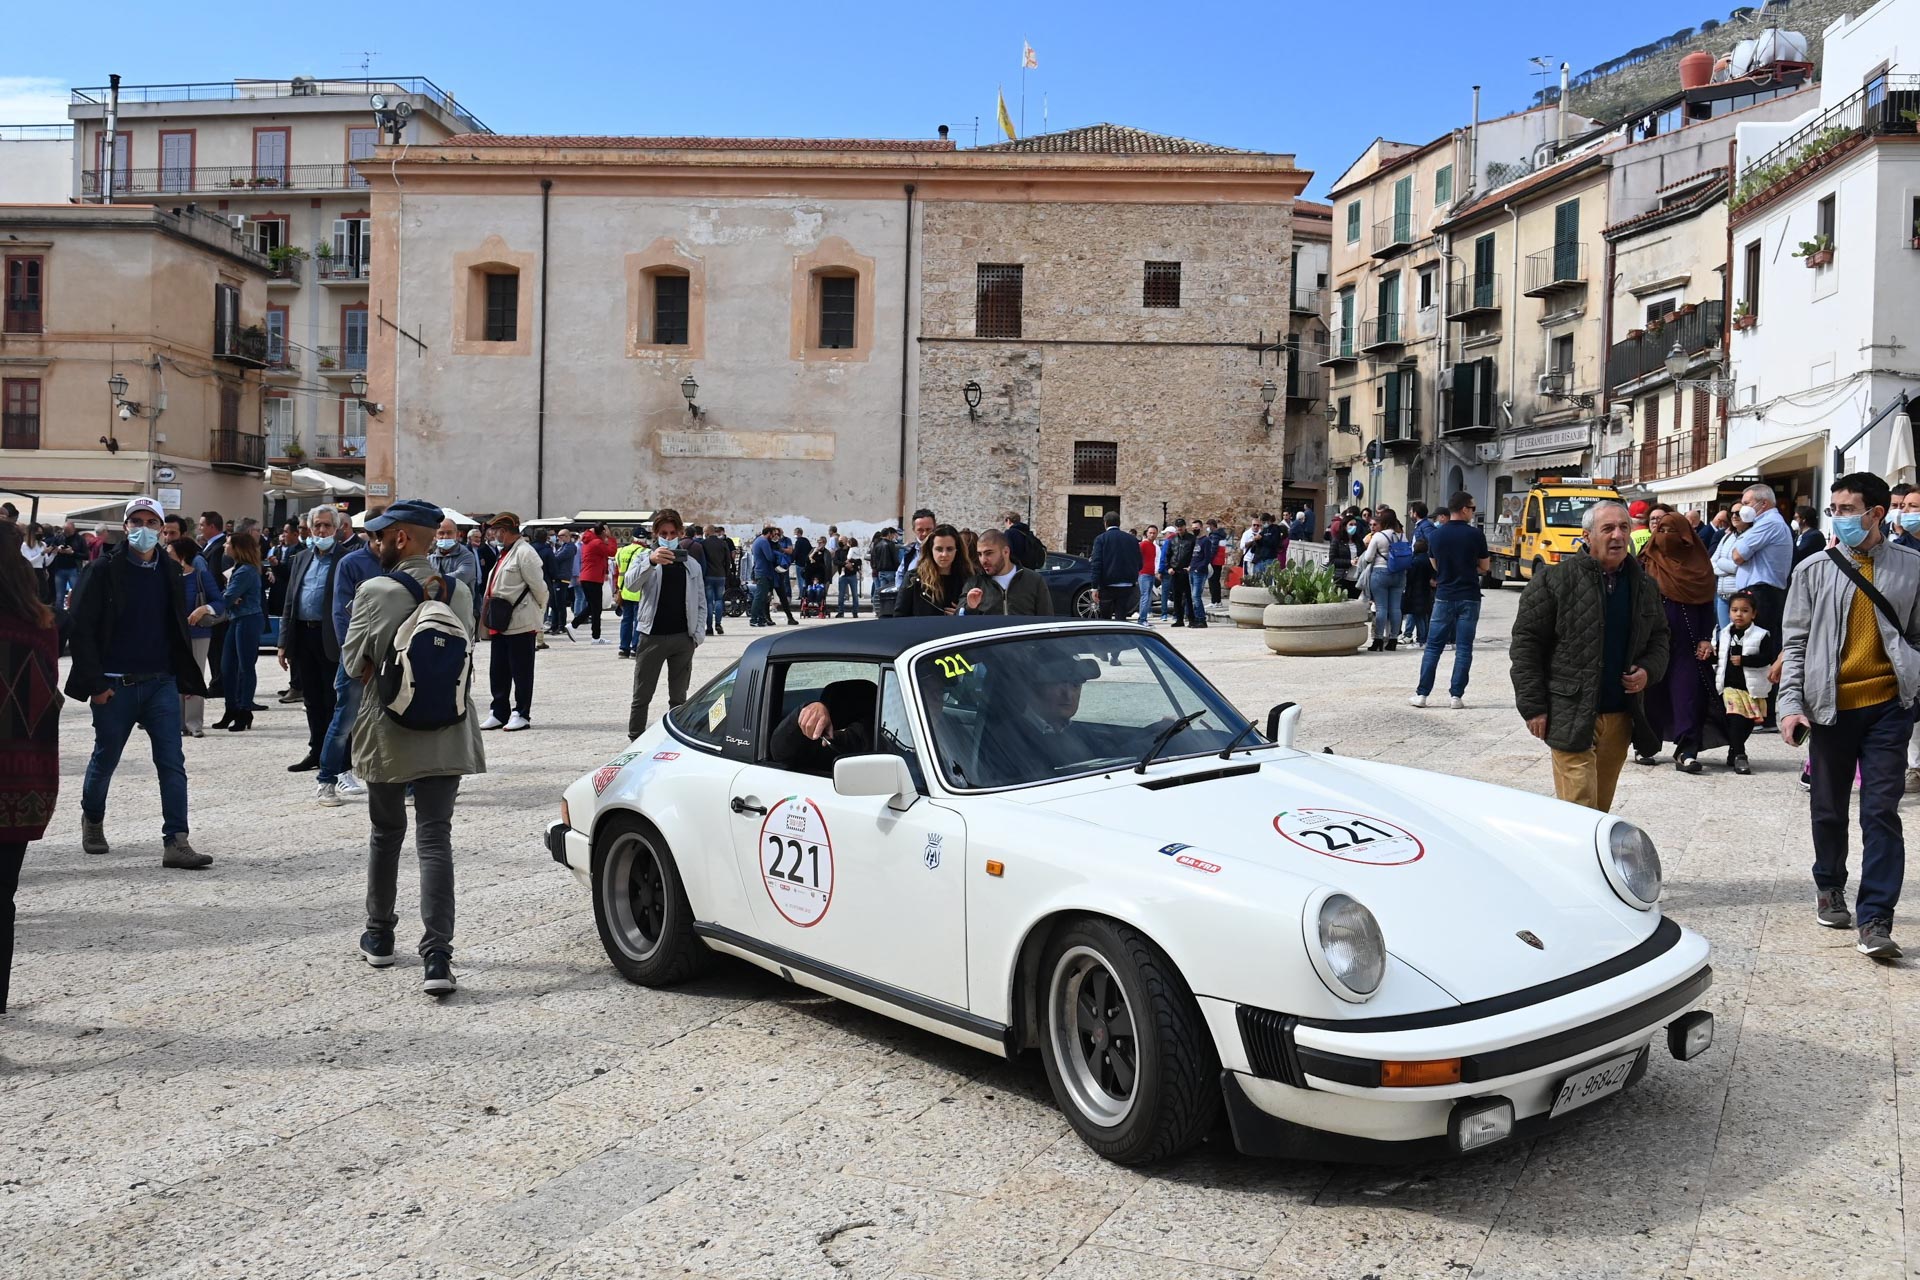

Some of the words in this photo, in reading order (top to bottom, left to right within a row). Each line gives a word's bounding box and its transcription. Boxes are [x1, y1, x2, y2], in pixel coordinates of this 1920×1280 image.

[934, 653, 974, 678] 221
[1299, 820, 1393, 851] 221
[768, 835, 819, 888] 221
[1556, 1083, 1577, 1108] PA
